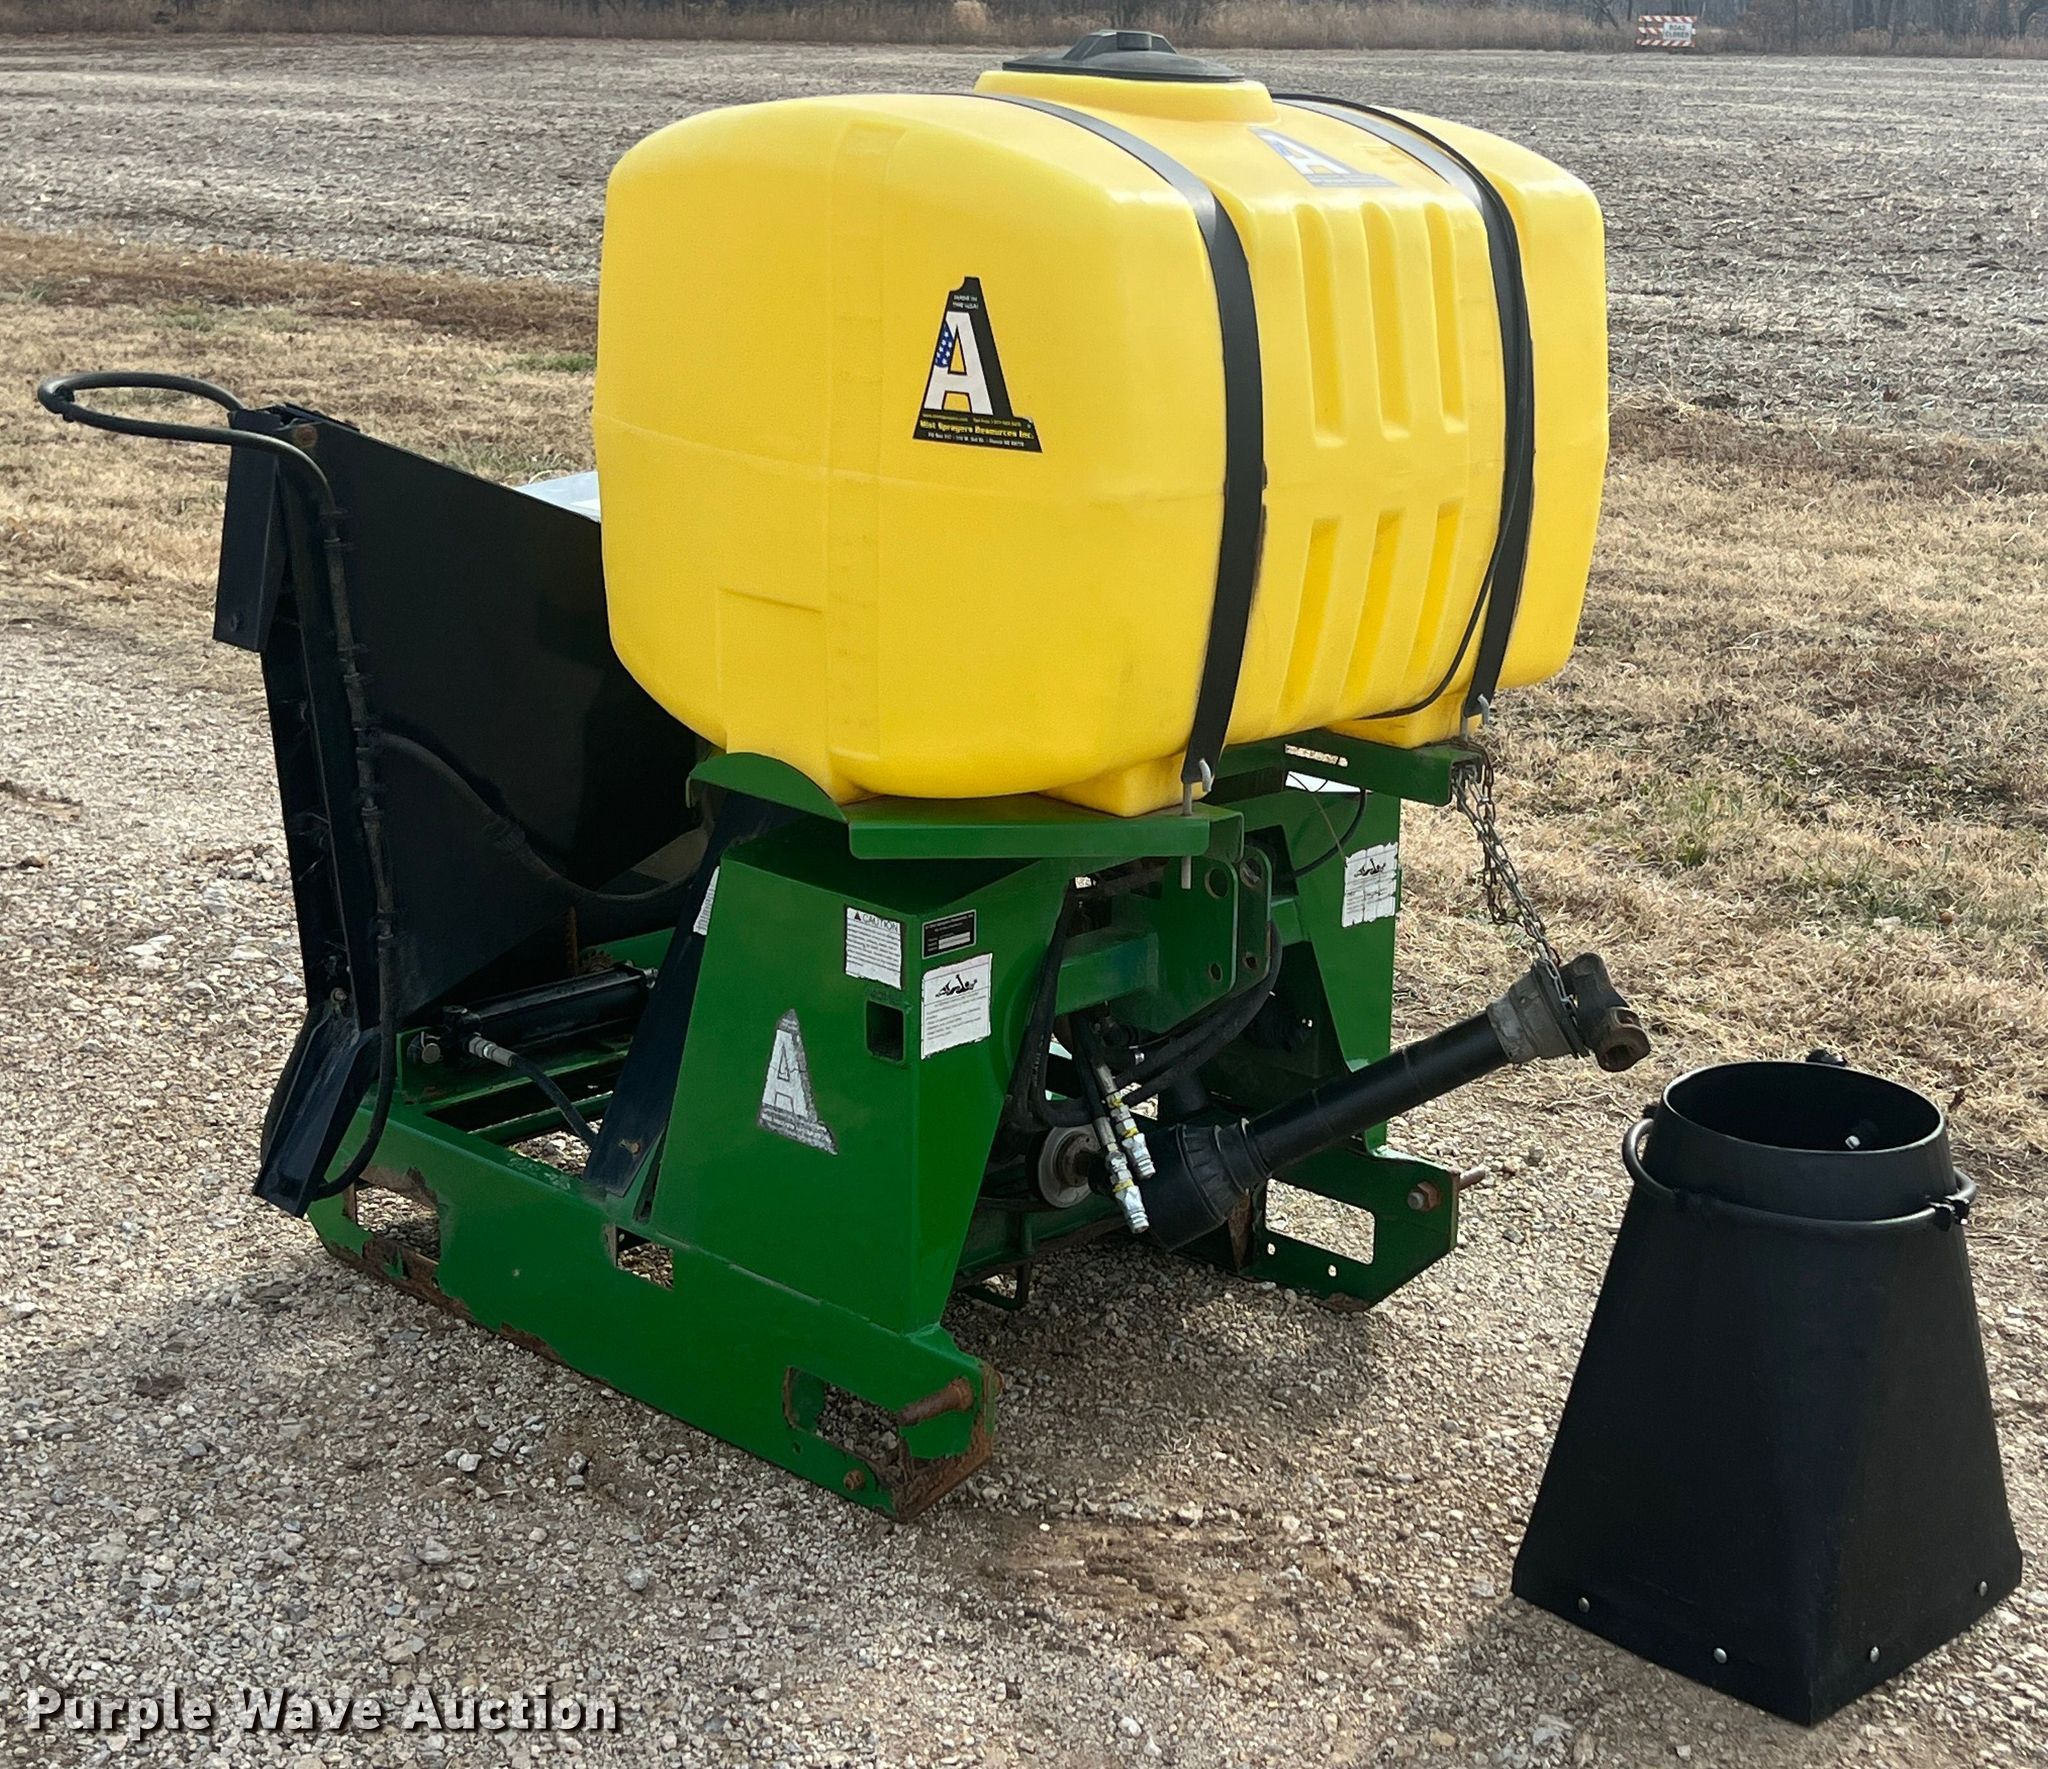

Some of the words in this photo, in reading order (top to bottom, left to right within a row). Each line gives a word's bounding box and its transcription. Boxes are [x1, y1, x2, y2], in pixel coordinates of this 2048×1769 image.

[920, 420, 936, 429] Mist
[938, 422, 973, 433] Sprayers
[974, 425, 1017, 437] Resources
[862, 913, 899, 933] CAUTION
